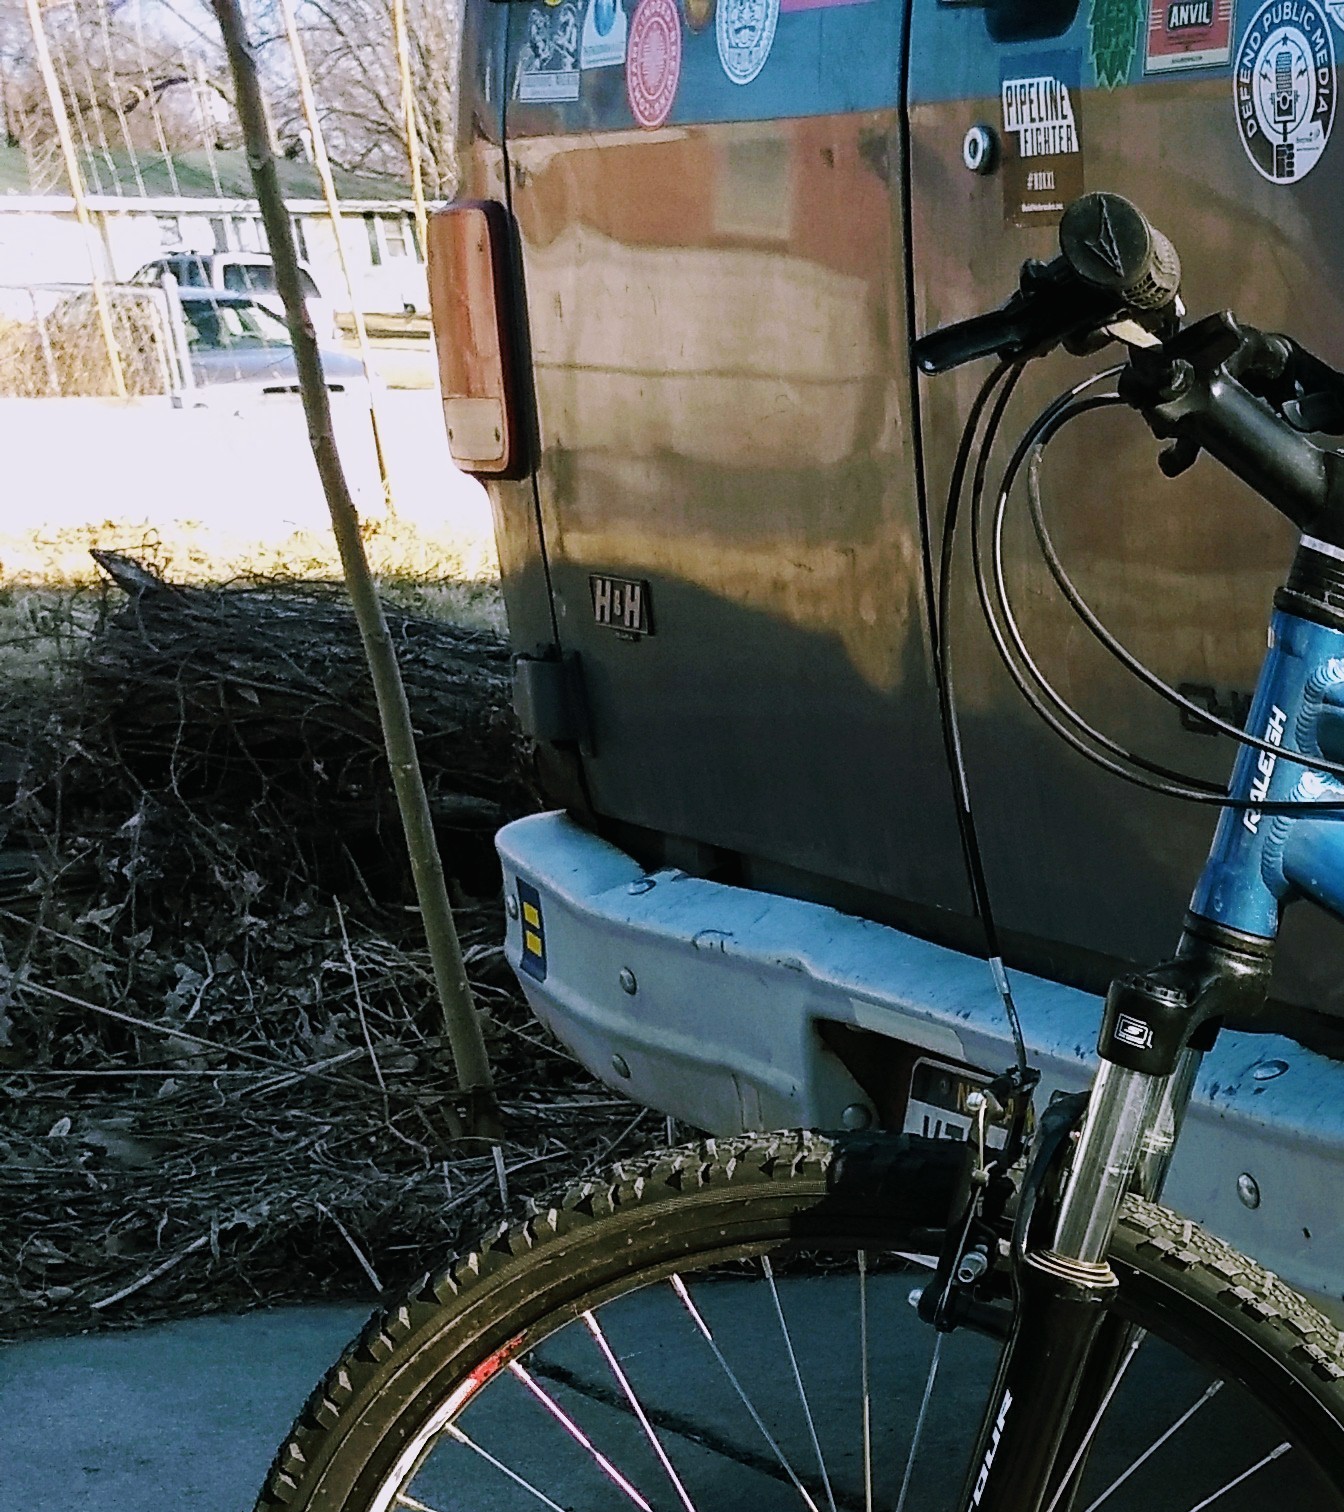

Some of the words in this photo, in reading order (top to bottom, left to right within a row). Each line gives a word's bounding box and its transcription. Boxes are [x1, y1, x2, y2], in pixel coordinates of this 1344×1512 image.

[1169, 1, 1211, 28] ANVIL
[1239, 31, 1261, 138] DEFEND
[1262, 1, 1315, 32] PUBLIC
[1311, 28, 1330, 113] MEDIA
[1004, 80, 1068, 127] PIPELINE
[1023, 124, 1073, 156] FIGHTER
